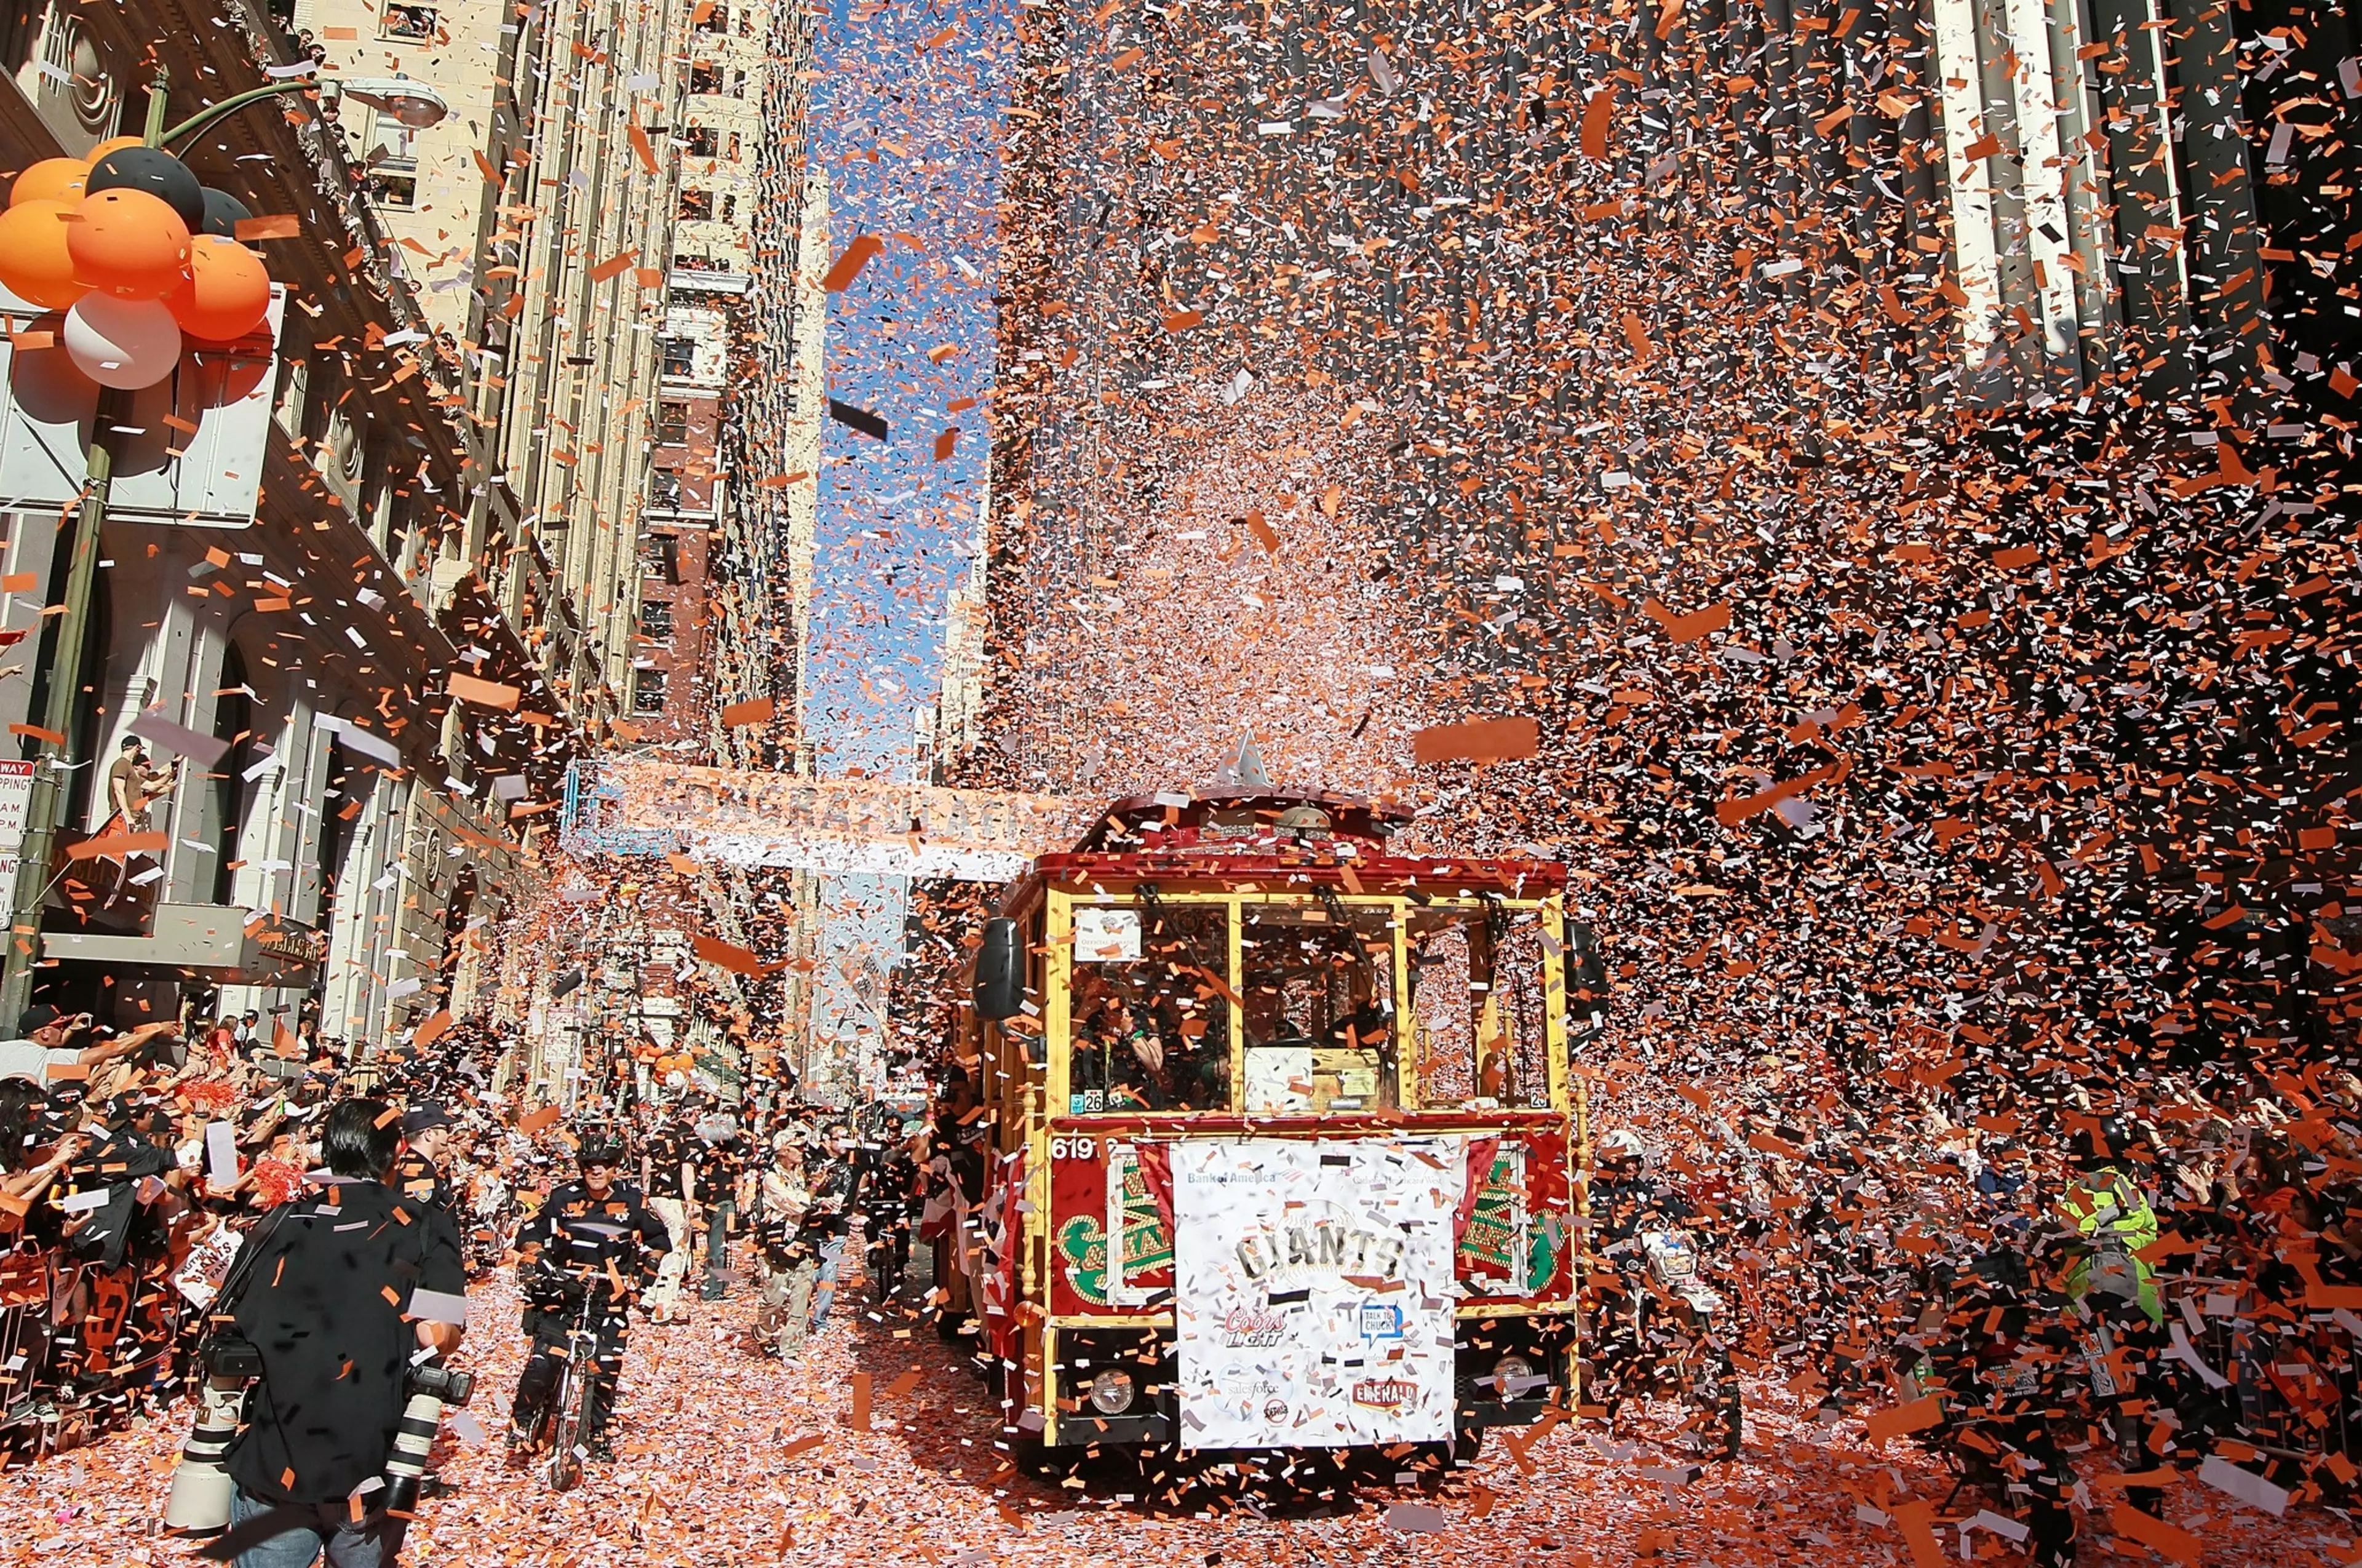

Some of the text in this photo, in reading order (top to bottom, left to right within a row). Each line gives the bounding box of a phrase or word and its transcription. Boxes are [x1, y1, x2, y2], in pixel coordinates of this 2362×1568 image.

[1086, 1095, 1102, 1110] 26
[1187, 1172, 1216, 1184] Bank
[1230, 1172, 1276, 1184] Ameca
[1235, 1226, 1405, 1279] GIANTS
[1225, 1307, 1286, 1334] Coors
[1365, 1311, 1381, 1320] TALK
[1227, 1380, 1279, 1401] salesforce
